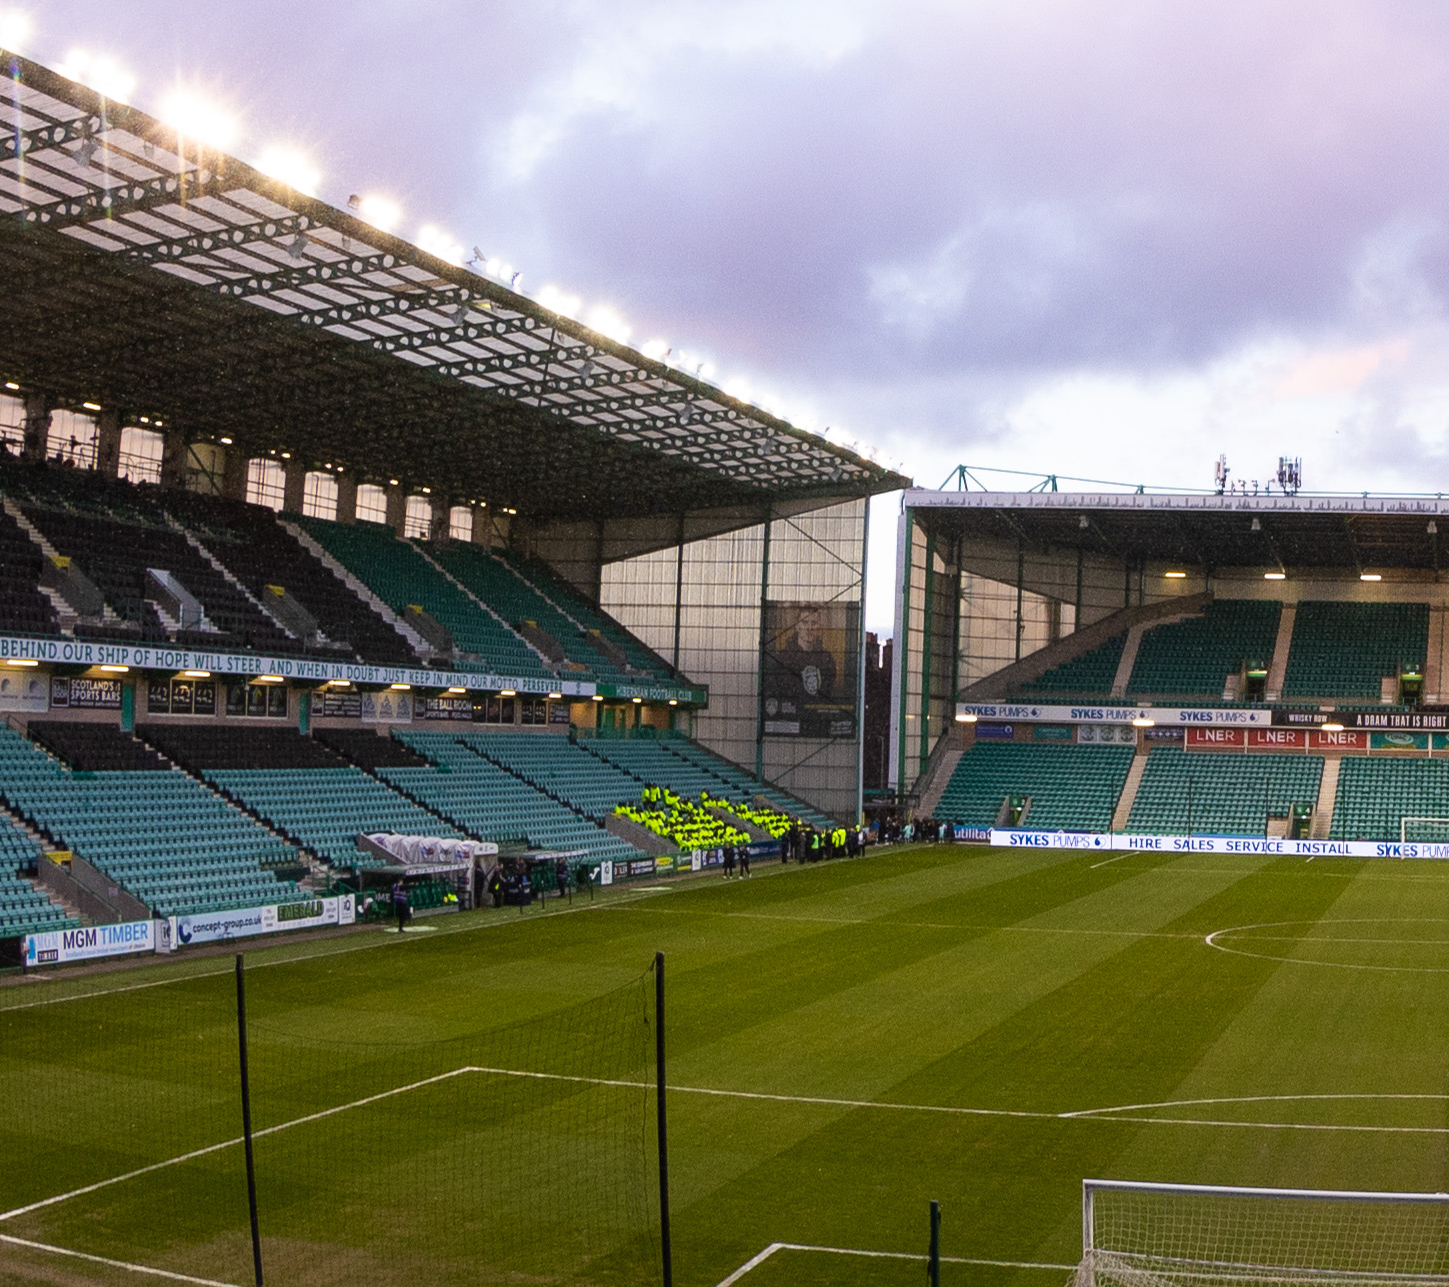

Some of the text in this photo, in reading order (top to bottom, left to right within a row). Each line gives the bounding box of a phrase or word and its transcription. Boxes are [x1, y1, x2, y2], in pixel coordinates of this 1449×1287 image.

[63, 643, 93, 662] OUR
[98, 646, 129, 663] SHIP
[134, 649, 150, 665] OF
[155, 651, 189, 668] HOPE
[193, 653, 223, 670] WILL
[269, 660, 293, 675] AND
[296, 663, 328, 678] WHEN
[331, 665, 343, 679] IN
[346, 666, 380, 681] DOUBT
[383, 669, 406, 683] JUST
[409, 670, 431, 685] KEEP
[433, 673, 443, 685] IN
[446, 674, 469, 687] MIND
[471, 676, 488, 688] OUR
[522, 678, 563, 693] PERSEVERE
[71, 690, 121, 702] SPORTS BARS
[616, 686, 692, 701] HIBERNIAN FOOTBALL CLUB
[965, 705, 1029, 718] SYKES PUMPS
[1357, 715, 1363, 726] A
[1365, 715, 1388, 726] DRAM
[1390, 715, 1411, 726] THAT
[1412, 715, 1421, 727] IS
[1423, 716, 1447, 727] RIGHT
[1196, 729, 1235, 742] LNER
[1318, 732, 1357, 744] LNER
[954, 828, 989, 841] utilita
[278, 901, 325, 922] EMERALD
[193, 917, 262, 934] concept-group.co.uk
[63, 928, 97, 951] MGM
[100, 923, 148, 944] TIMBER
